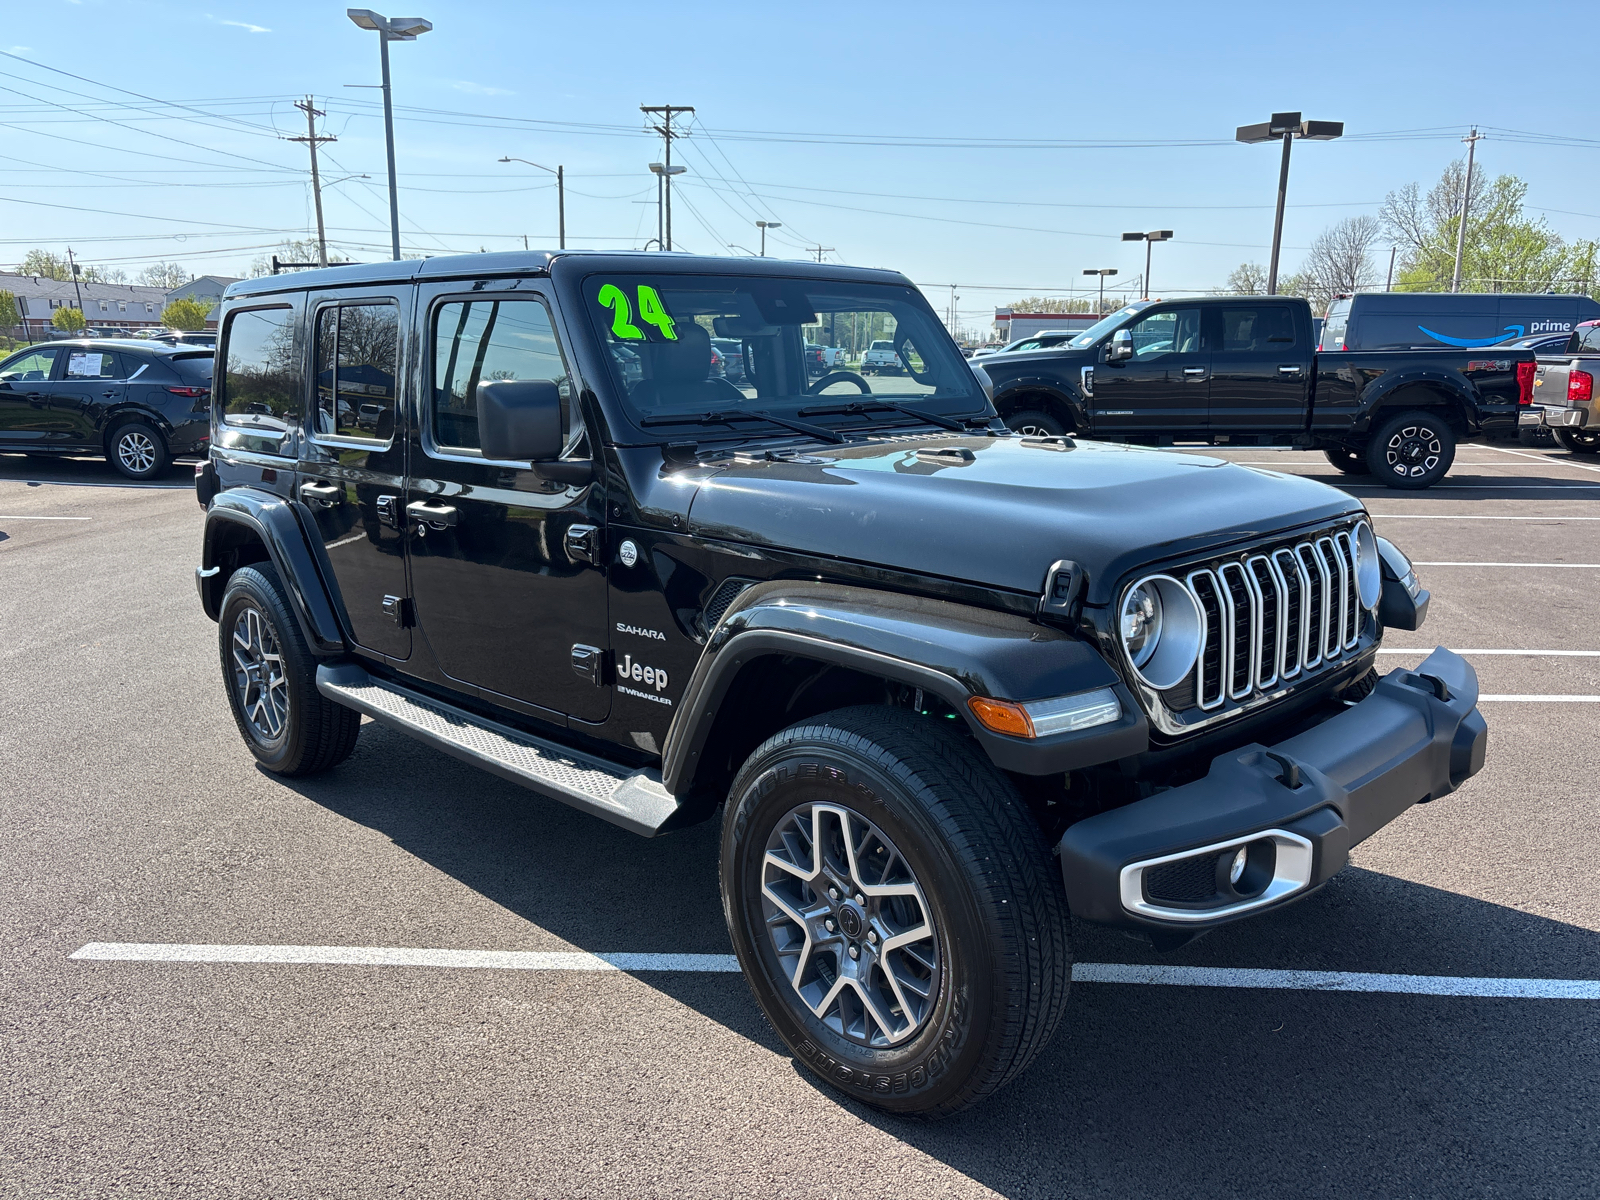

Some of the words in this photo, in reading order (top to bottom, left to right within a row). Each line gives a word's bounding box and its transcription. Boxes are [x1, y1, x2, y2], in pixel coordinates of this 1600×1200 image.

[598, 284, 678, 340] 24
[1530, 319, 1571, 334] prime
[1468, 360, 1511, 371] FX4
[616, 622, 666, 641] SAHARA
[617, 654, 669, 692] Jeep
[625, 688, 672, 706] WRANGLER
